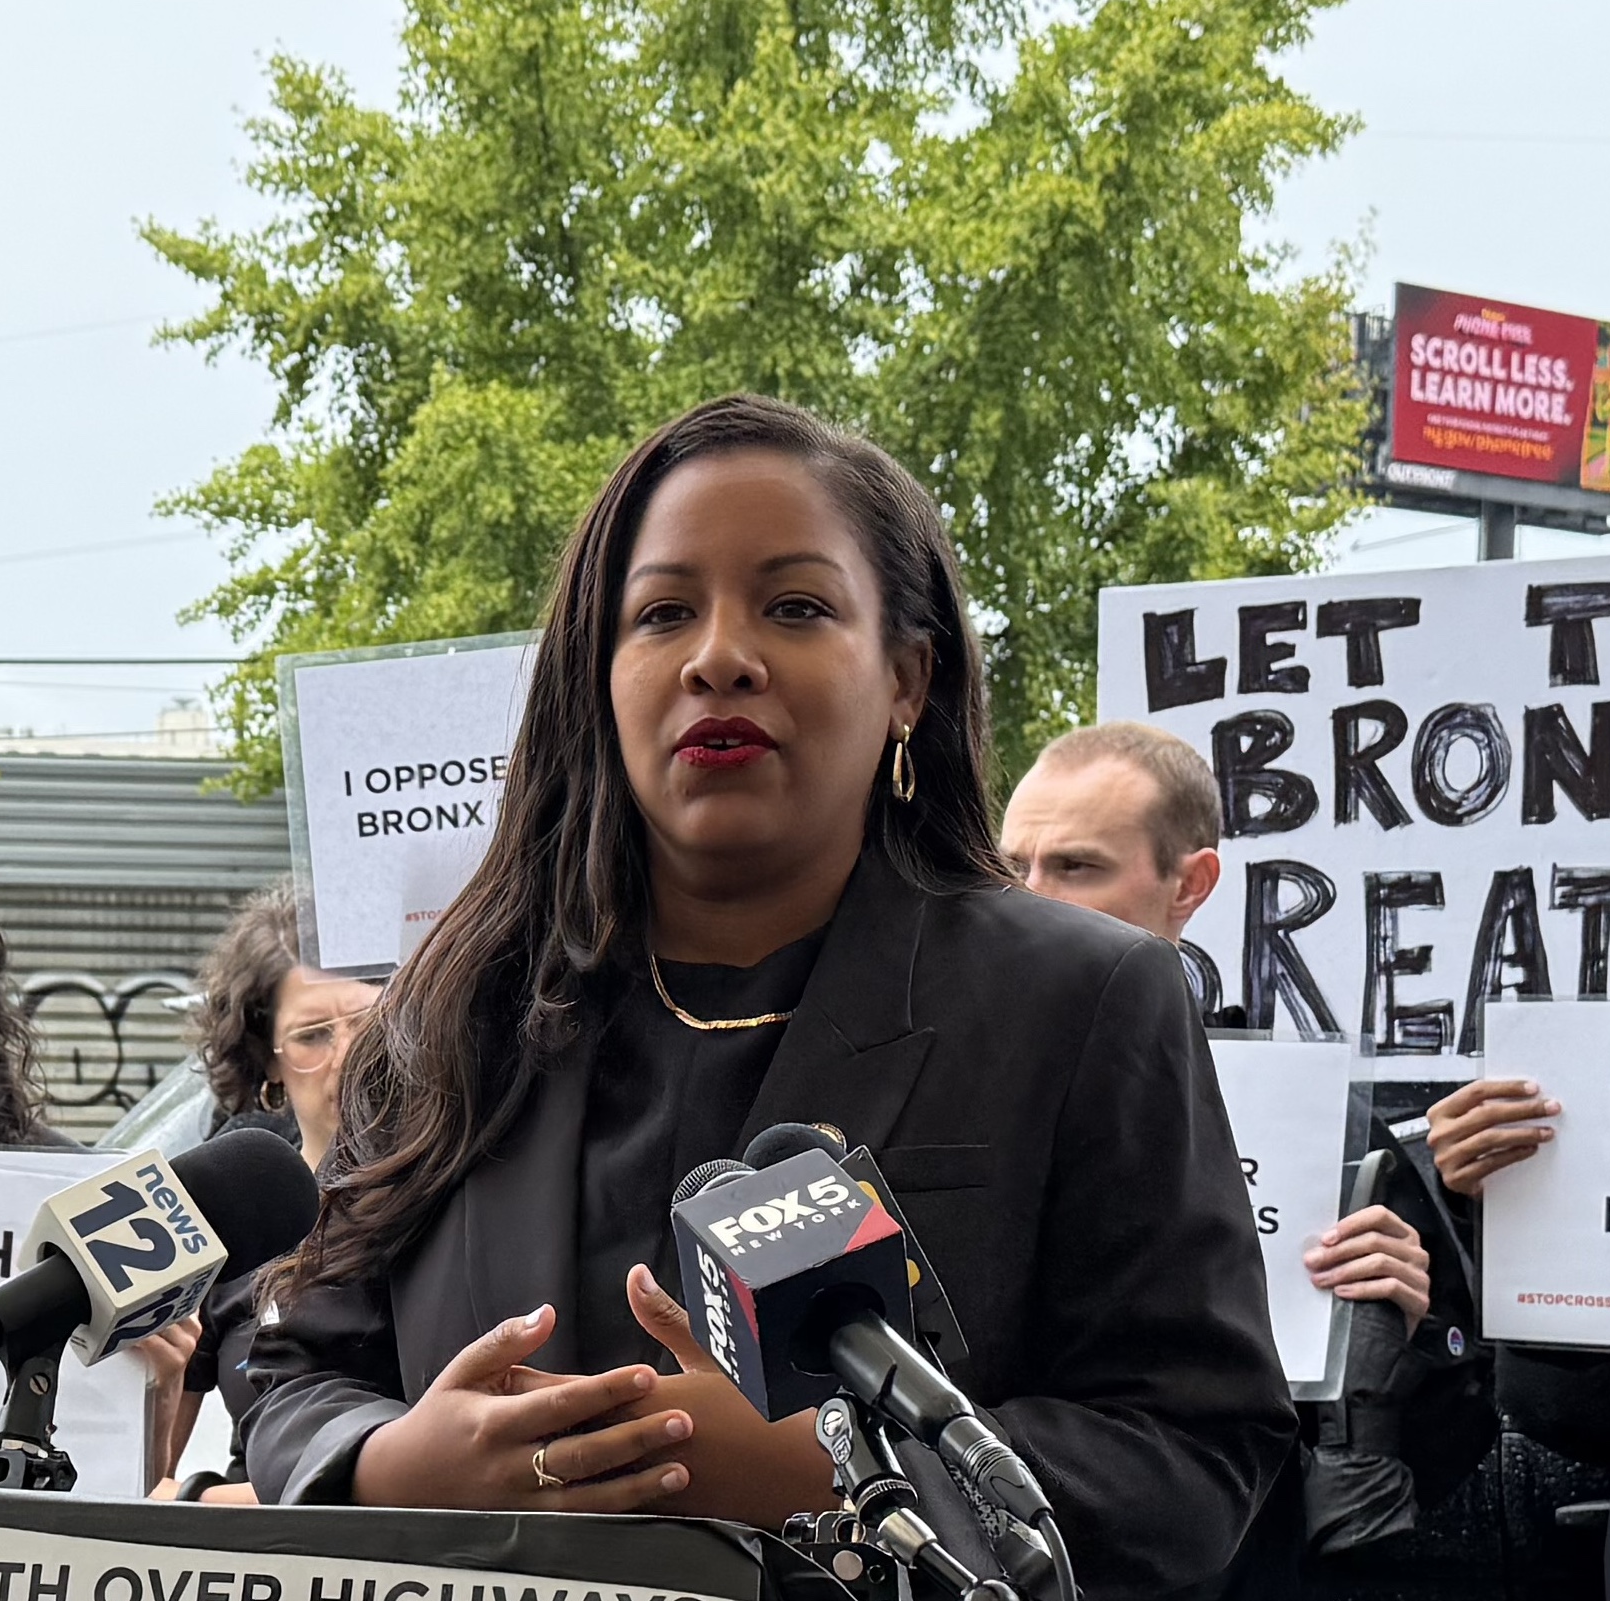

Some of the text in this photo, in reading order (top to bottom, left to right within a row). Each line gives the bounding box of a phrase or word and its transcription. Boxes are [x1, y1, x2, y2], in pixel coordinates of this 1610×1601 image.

[1410, 333, 1574, 392] SCROLL LESS.
[1410, 369, 1572, 425] LEARN MORE.
[1143, 597, 1421, 713] LET
[344, 756, 508, 796] I OPPOSE
[358, 800, 485, 837] BRONX
[69, 1181, 176, 1293] 12
[136, 1163, 208, 1255] news
[729, 1198, 862, 1257] NEW YORK
